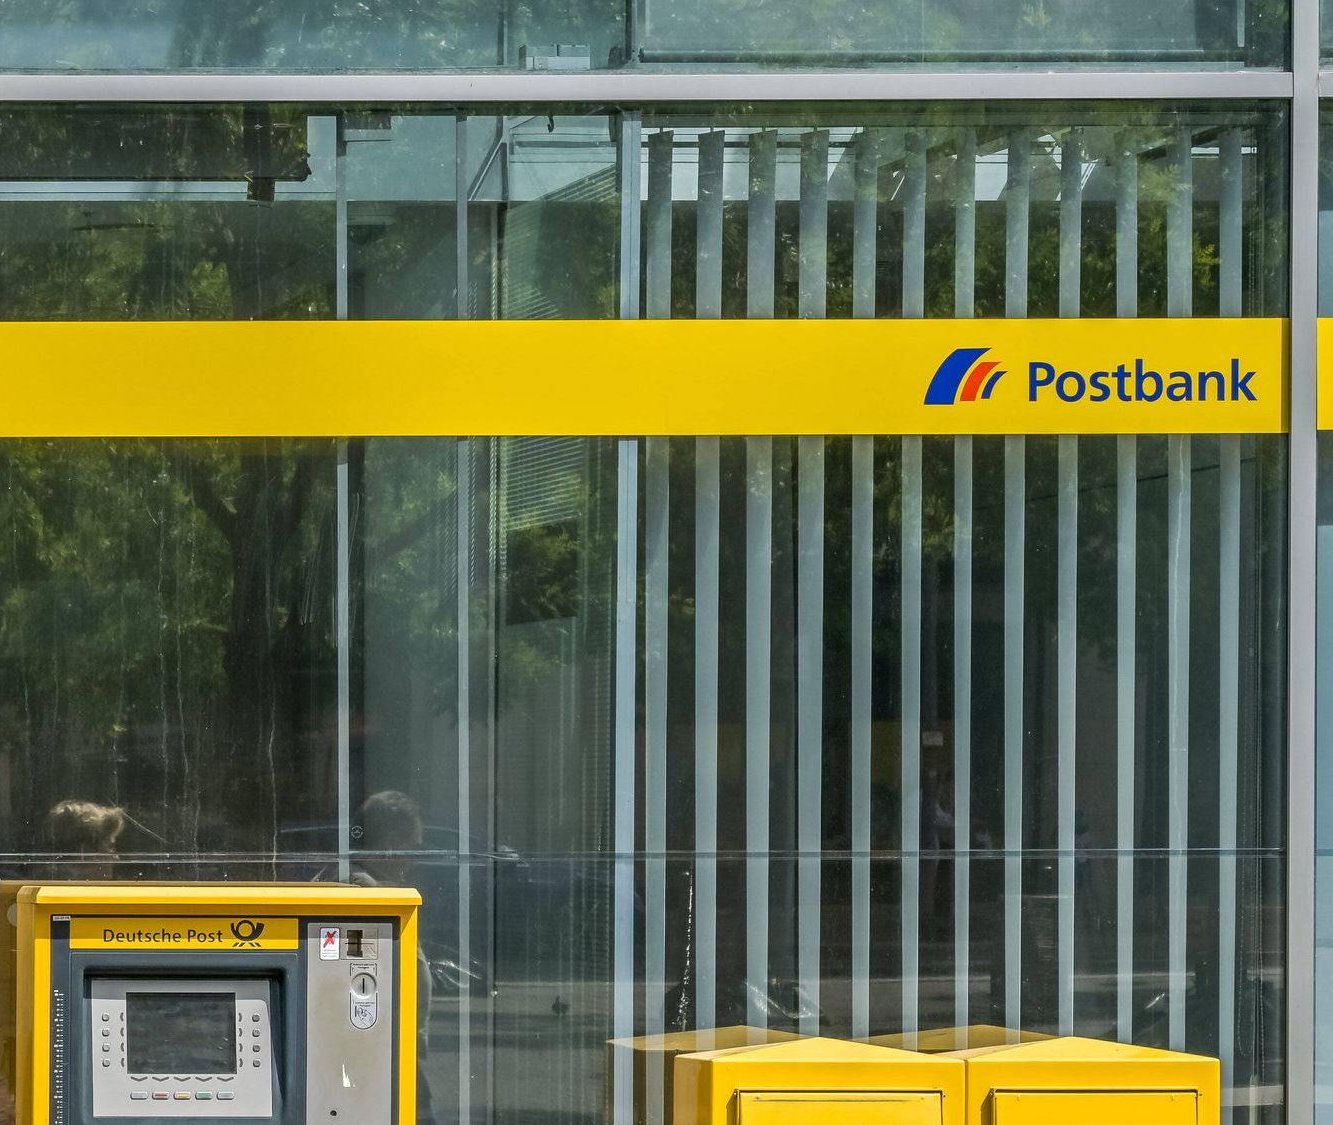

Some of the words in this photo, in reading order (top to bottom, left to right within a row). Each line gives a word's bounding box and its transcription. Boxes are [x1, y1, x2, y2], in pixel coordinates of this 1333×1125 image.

[1029, 359, 1257, 402] Postbank
[103, 929, 182, 943] Deutsche
[187, 929, 223, 943] Post
